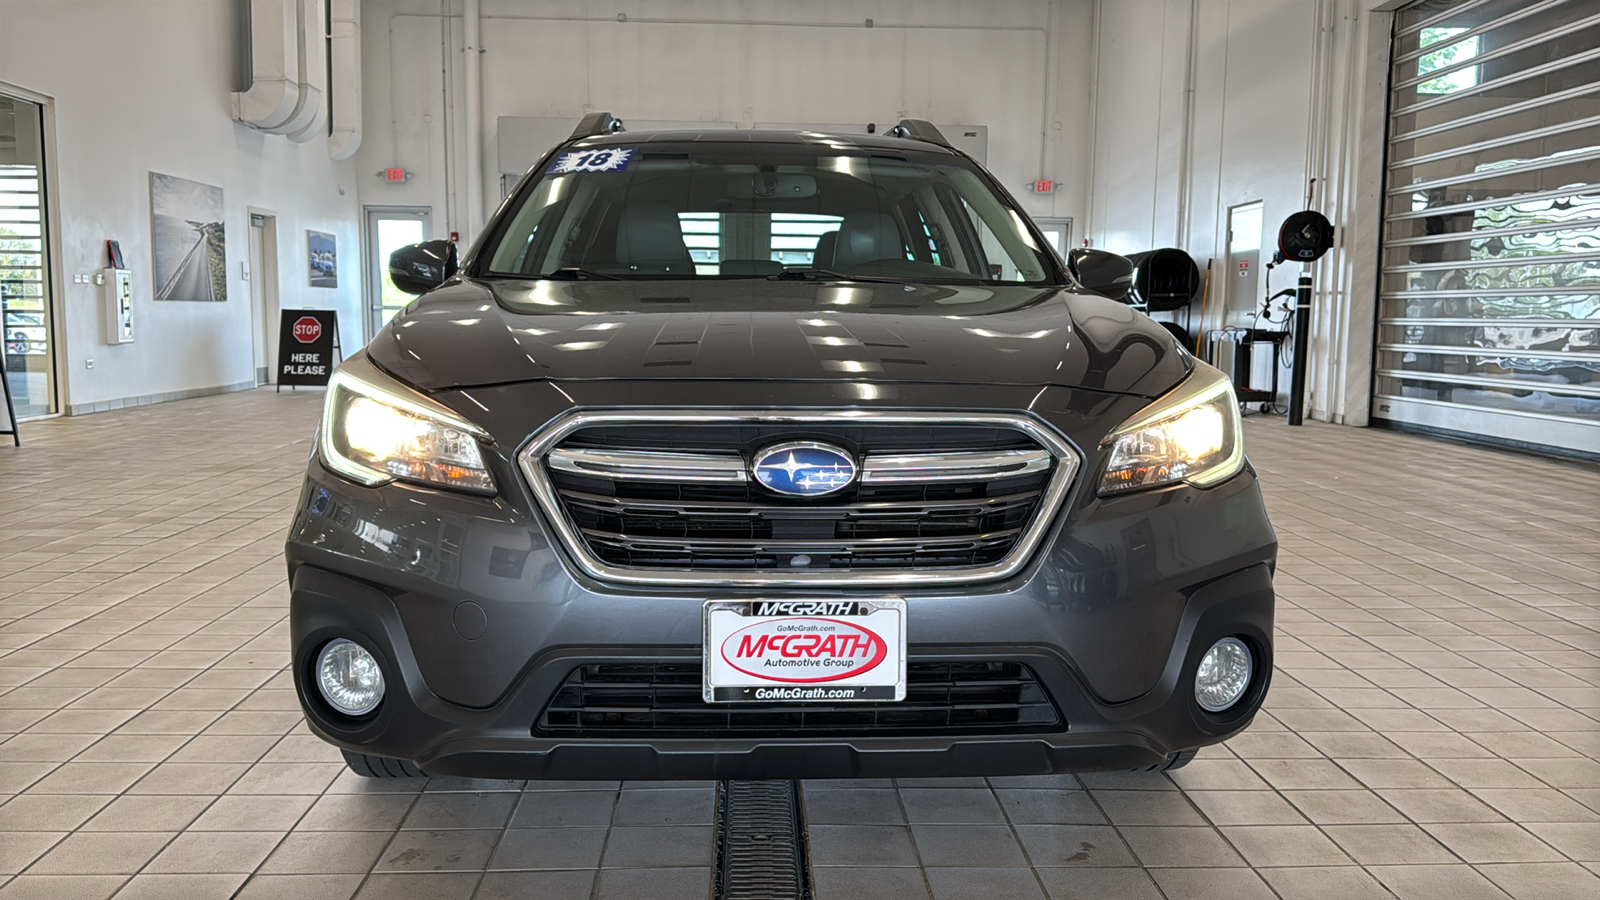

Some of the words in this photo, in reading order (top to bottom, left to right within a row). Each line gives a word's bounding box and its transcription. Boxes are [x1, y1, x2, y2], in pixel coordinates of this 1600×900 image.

[575, 153, 613, 167] 18
[387, 169, 402, 181] EXIT
[1037, 181, 1051, 192] EXIT
[295, 325, 319, 335] STOP
[291, 353, 320, 363] HERE
[283, 365, 326, 375] PLEASE
[776, 624, 835, 632] GoMcGrath.com
[764, 658, 821, 667] Automotive
[823, 659, 854, 668] Group
[755, 687, 855, 699] GoMcGrath.com
